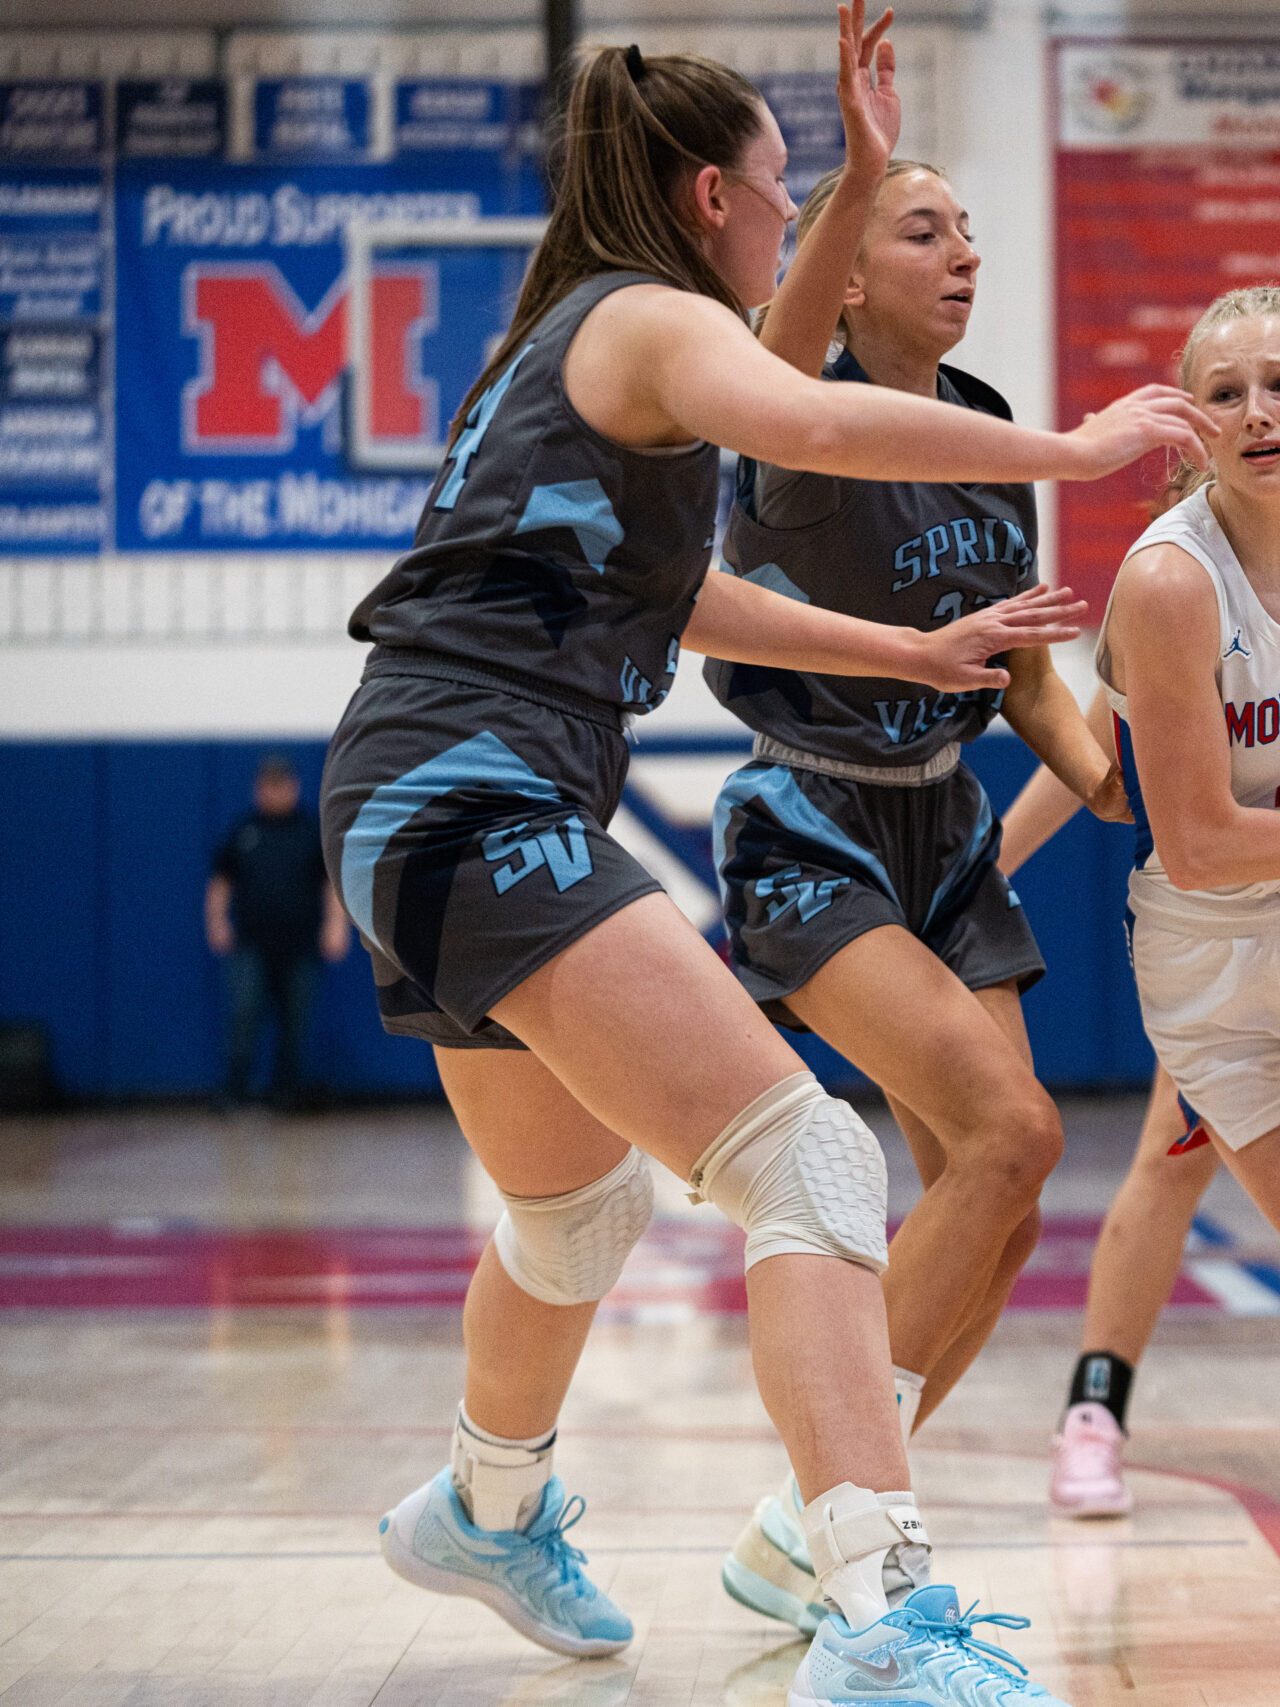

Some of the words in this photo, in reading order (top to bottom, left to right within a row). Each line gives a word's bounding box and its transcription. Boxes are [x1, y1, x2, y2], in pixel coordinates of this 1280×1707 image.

[182, 261, 440, 456] M
[481, 814, 594, 896] SV
[755, 862, 851, 924] SV
